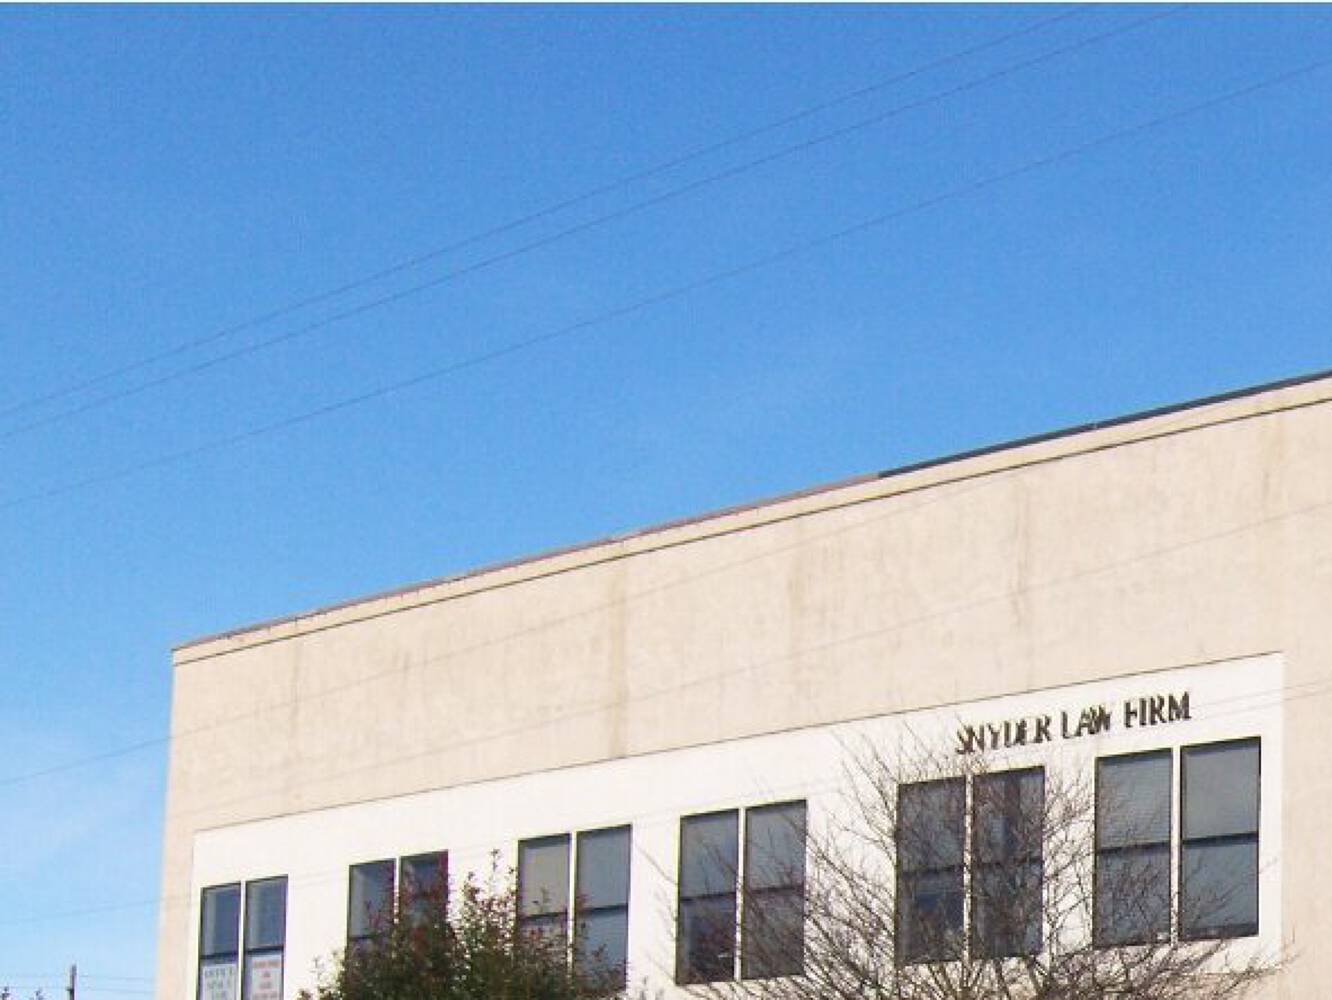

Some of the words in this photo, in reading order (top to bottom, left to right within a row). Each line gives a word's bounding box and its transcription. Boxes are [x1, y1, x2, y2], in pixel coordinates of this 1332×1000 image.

[956, 714, 1051, 755] SNYDER
[1061, 705, 1112, 739] LAW
[1123, 691, 1192, 729] FIRM
